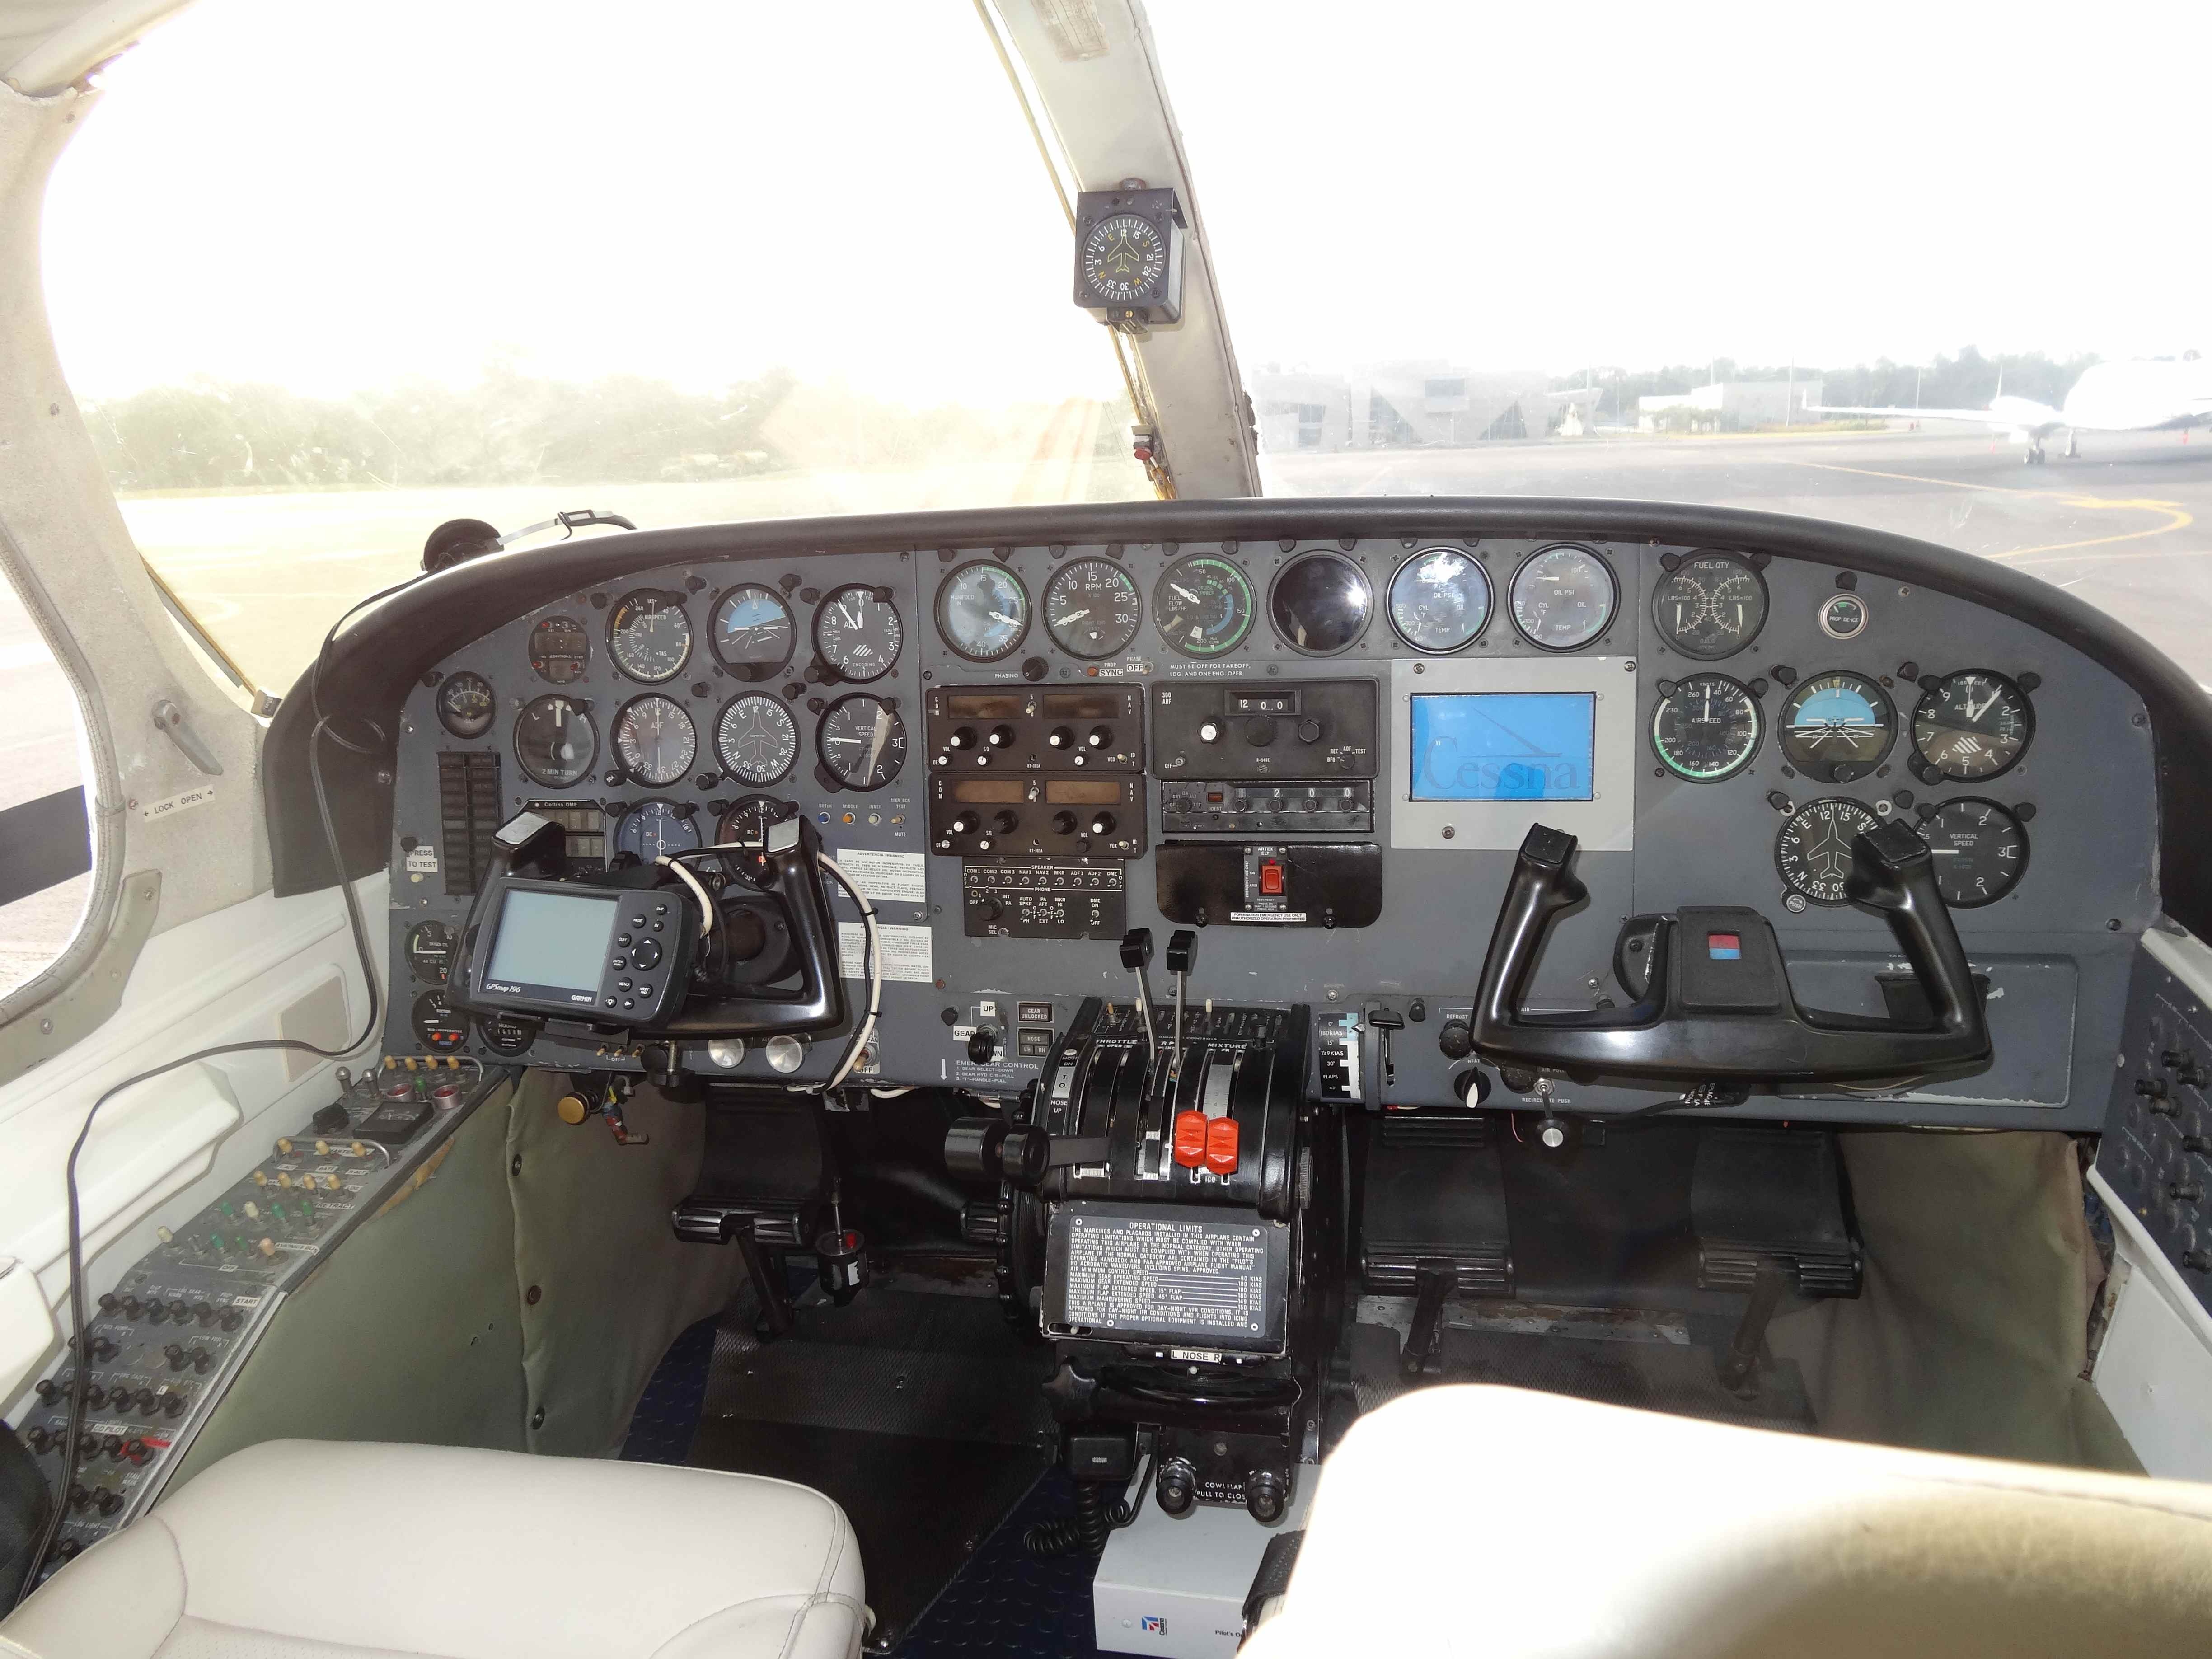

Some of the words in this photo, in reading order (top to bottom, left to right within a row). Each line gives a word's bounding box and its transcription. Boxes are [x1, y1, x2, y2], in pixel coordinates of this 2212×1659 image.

[1088, 572, 1097, 581] 15
[1069, 581, 1077, 590] 10
[1106, 579, 1119, 587] 20
[1114, 593, 1128, 601] 25
[888, 617, 894, 625] 2
[1115, 614, 1128, 623] 30
[1943, 692, 1950, 702] 9
[1928, 709, 1935, 719] 8
[1927, 732, 1934, 741] 7
[1940, 750, 1948, 759] 6
[1423, 735, 1580, 790] Cessna
[1962, 756, 1969, 766] 5
[154, 801, 174, 814] LOCK
[181, 793, 202, 804] OPEN
[1821, 811, 1831, 820] 12
[1840, 811, 1850, 821] 15
[1812, 881, 1826, 891] 33
[486, 983, 508, 993] GPSmap
[1129, 1222, 1175, 1231] OPERATIONAL
[1179, 1224, 1202, 1232] LIMITS
[235, 1297, 258, 1306] START
